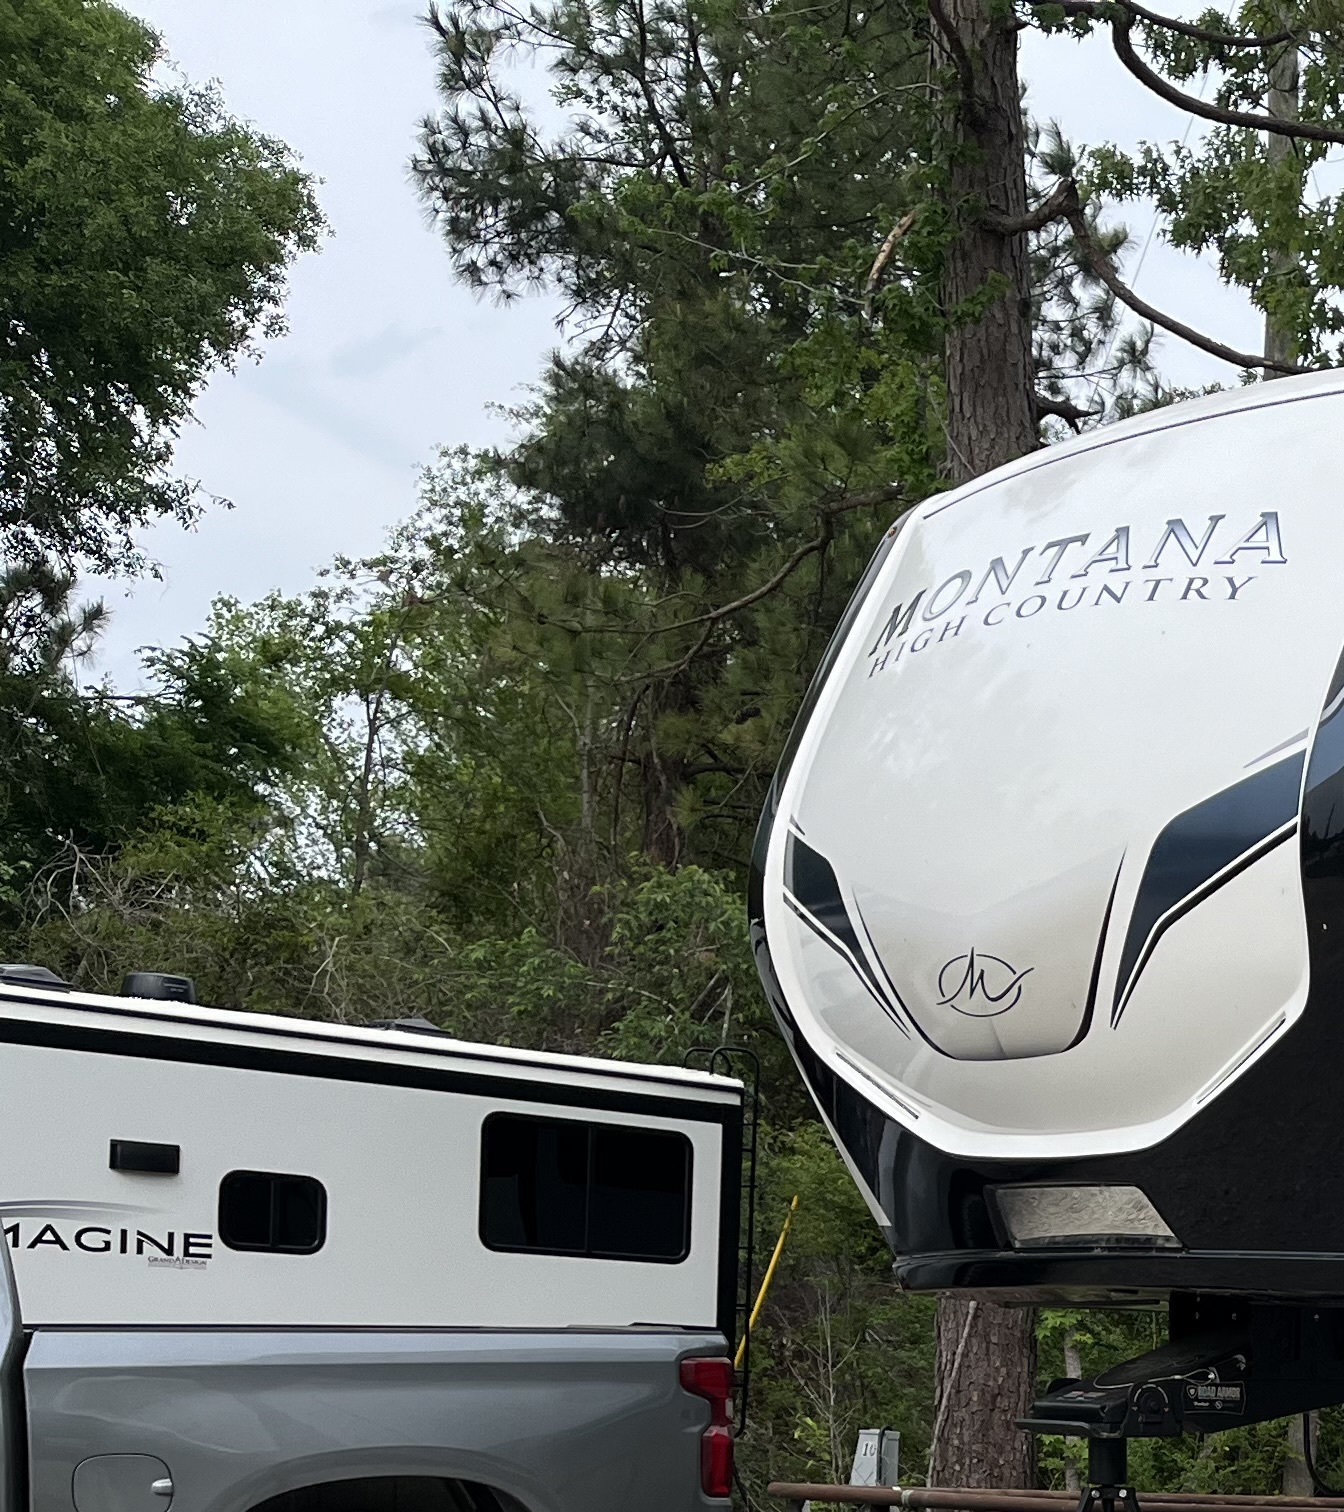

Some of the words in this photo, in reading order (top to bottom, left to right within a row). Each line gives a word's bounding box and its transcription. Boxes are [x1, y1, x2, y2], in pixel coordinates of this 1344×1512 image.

[868, 511, 1288, 658] MONTANA
[868, 615, 969, 679] HIGH
[983, 576, 1259, 628] COUNTRY
